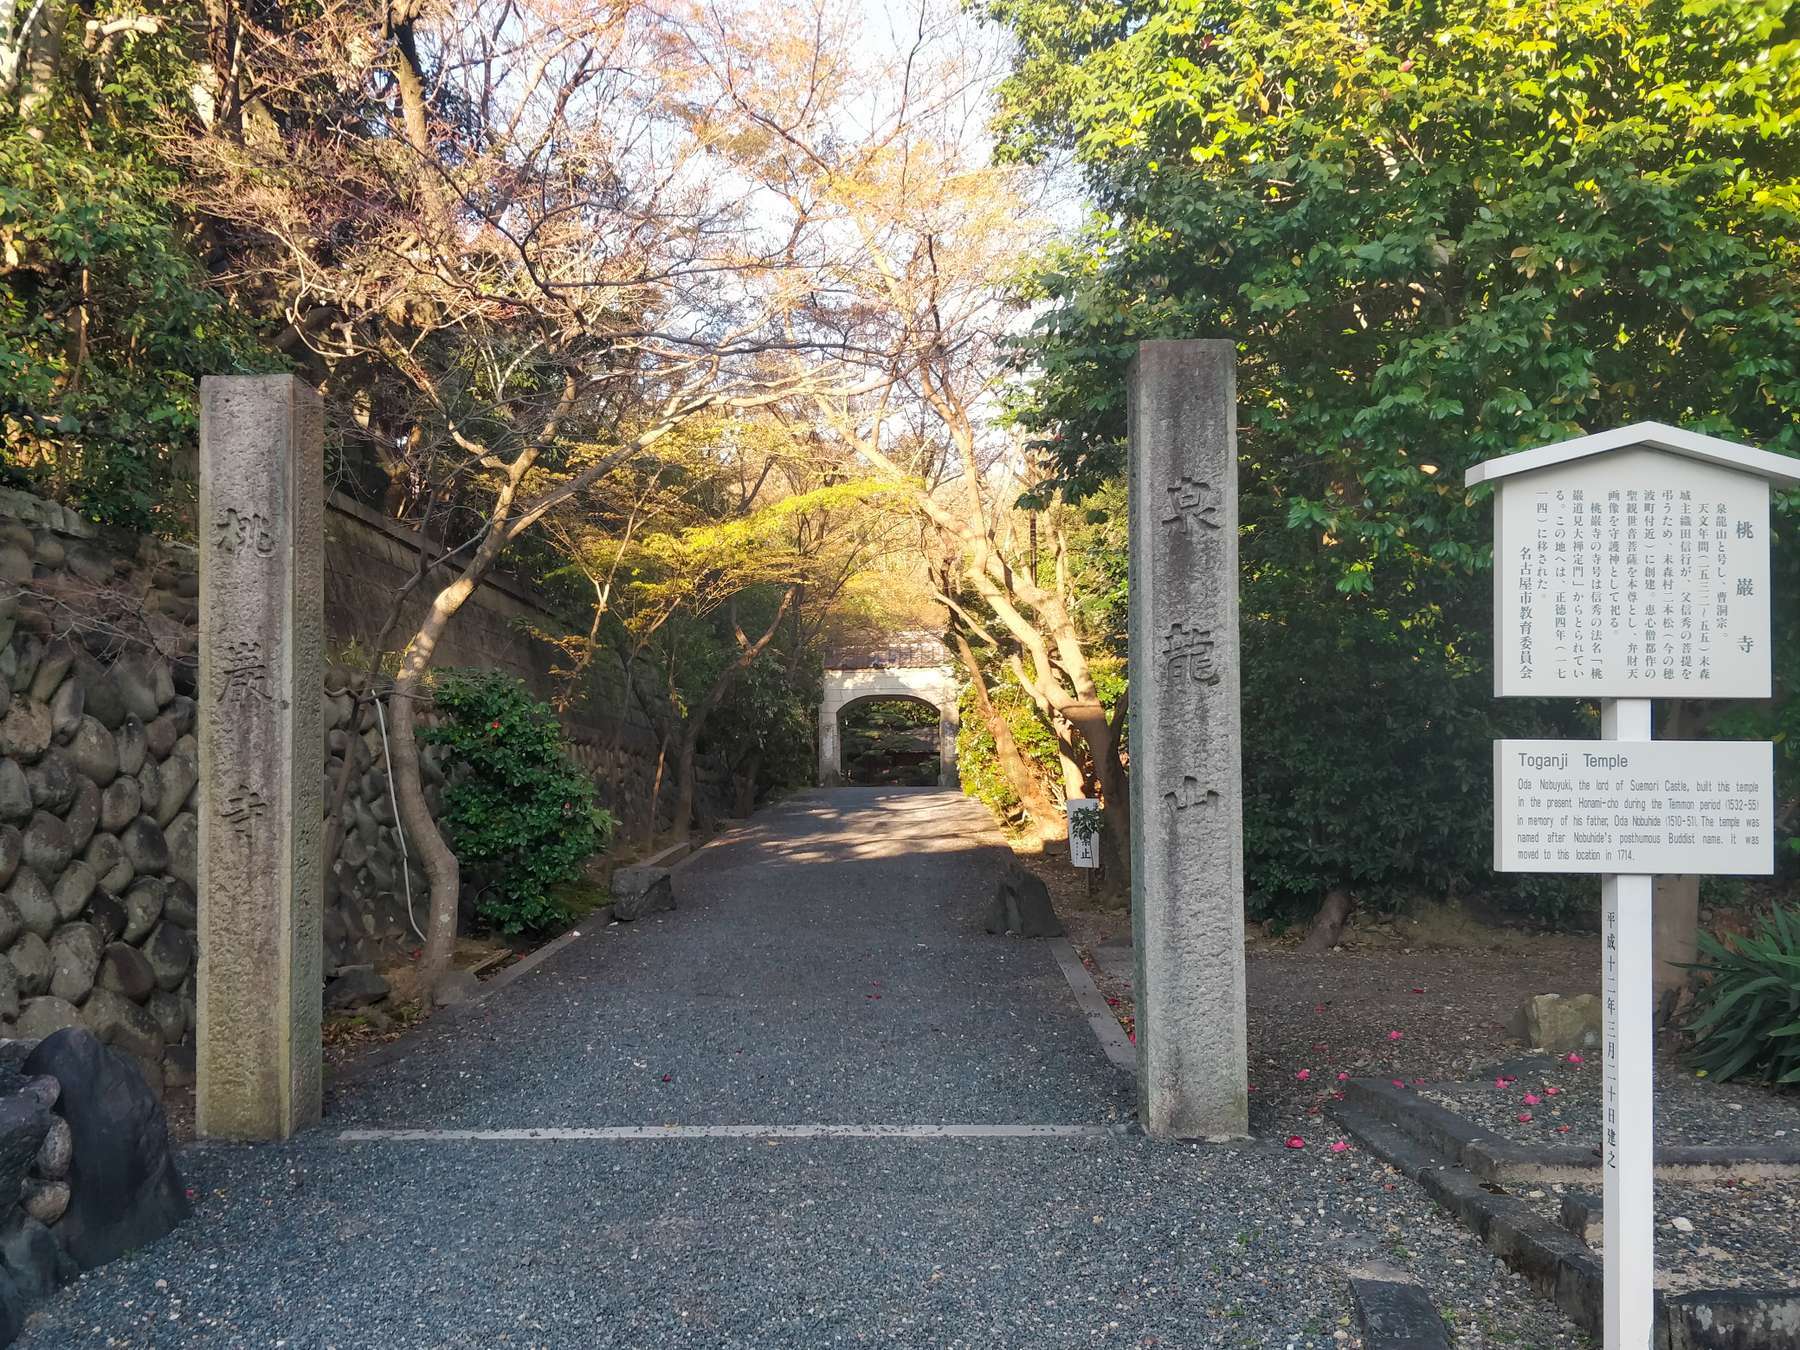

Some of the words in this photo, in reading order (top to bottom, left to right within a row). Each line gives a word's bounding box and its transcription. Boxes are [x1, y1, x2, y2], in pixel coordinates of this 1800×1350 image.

[1716, 503, 1729, 638] 泉龍山と号し、曹洞宗。
[1736, 520, 1755, 655] 桃巌寺
[1519, 546, 1533, 680] 名古屋市教育委員会
[1162, 476, 1220, 811] 泉龍山
[1518, 753, 1568, 770] Toganji
[1582, 753, 1629, 770] Temple
[1518, 778, 1532, 790] Oda
[1579, 779, 1590, 791] the
[1596, 780, 1609, 791] lord
[1616, 780, 1624, 791] of
[1630, 779, 1659, 792] Suemori
[1697, 780, 1712, 792] built
[1718, 780, 1730, 792] this
[1736, 781, 1759, 794] temple
[1518, 797, 1524, 807] in
[1530, 797, 1541, 808] the
[1547, 798, 1572, 810] present
[1578, 798, 1619, 809] Honami-cho
[1624, 798, 1645, 811] during
[1652, 798, 1663, 809] the
[1699, 799, 1721, 812] period
[1517, 815, 1523, 826] in
[1528, 816, 1553, 828] memory
[1560, 815, 1568, 826] of
[1573, 815, 1583, 826] his
[1614, 815, 1629, 827] Oda
[1701, 816, 1714, 827] The
[1719, 817, 1740, 830] temple
[1746, 818, 1760, 828] was
[1517, 832, 1539, 844] named
[1547, 832, 1566, 843] after
[1619, 833, 1661, 845] posthumous
[1745, 834, 1760, 845] was
[1517, 849, 1539, 860] moved
[1544, 849, 1551, 860] to
[1557, 849, 1569, 861] this
[1575, 849, 1601, 861] location
[1606, 849, 1612, 861] in
[1606, 911, 1617, 1169] 平成十二年三月二十日建之
